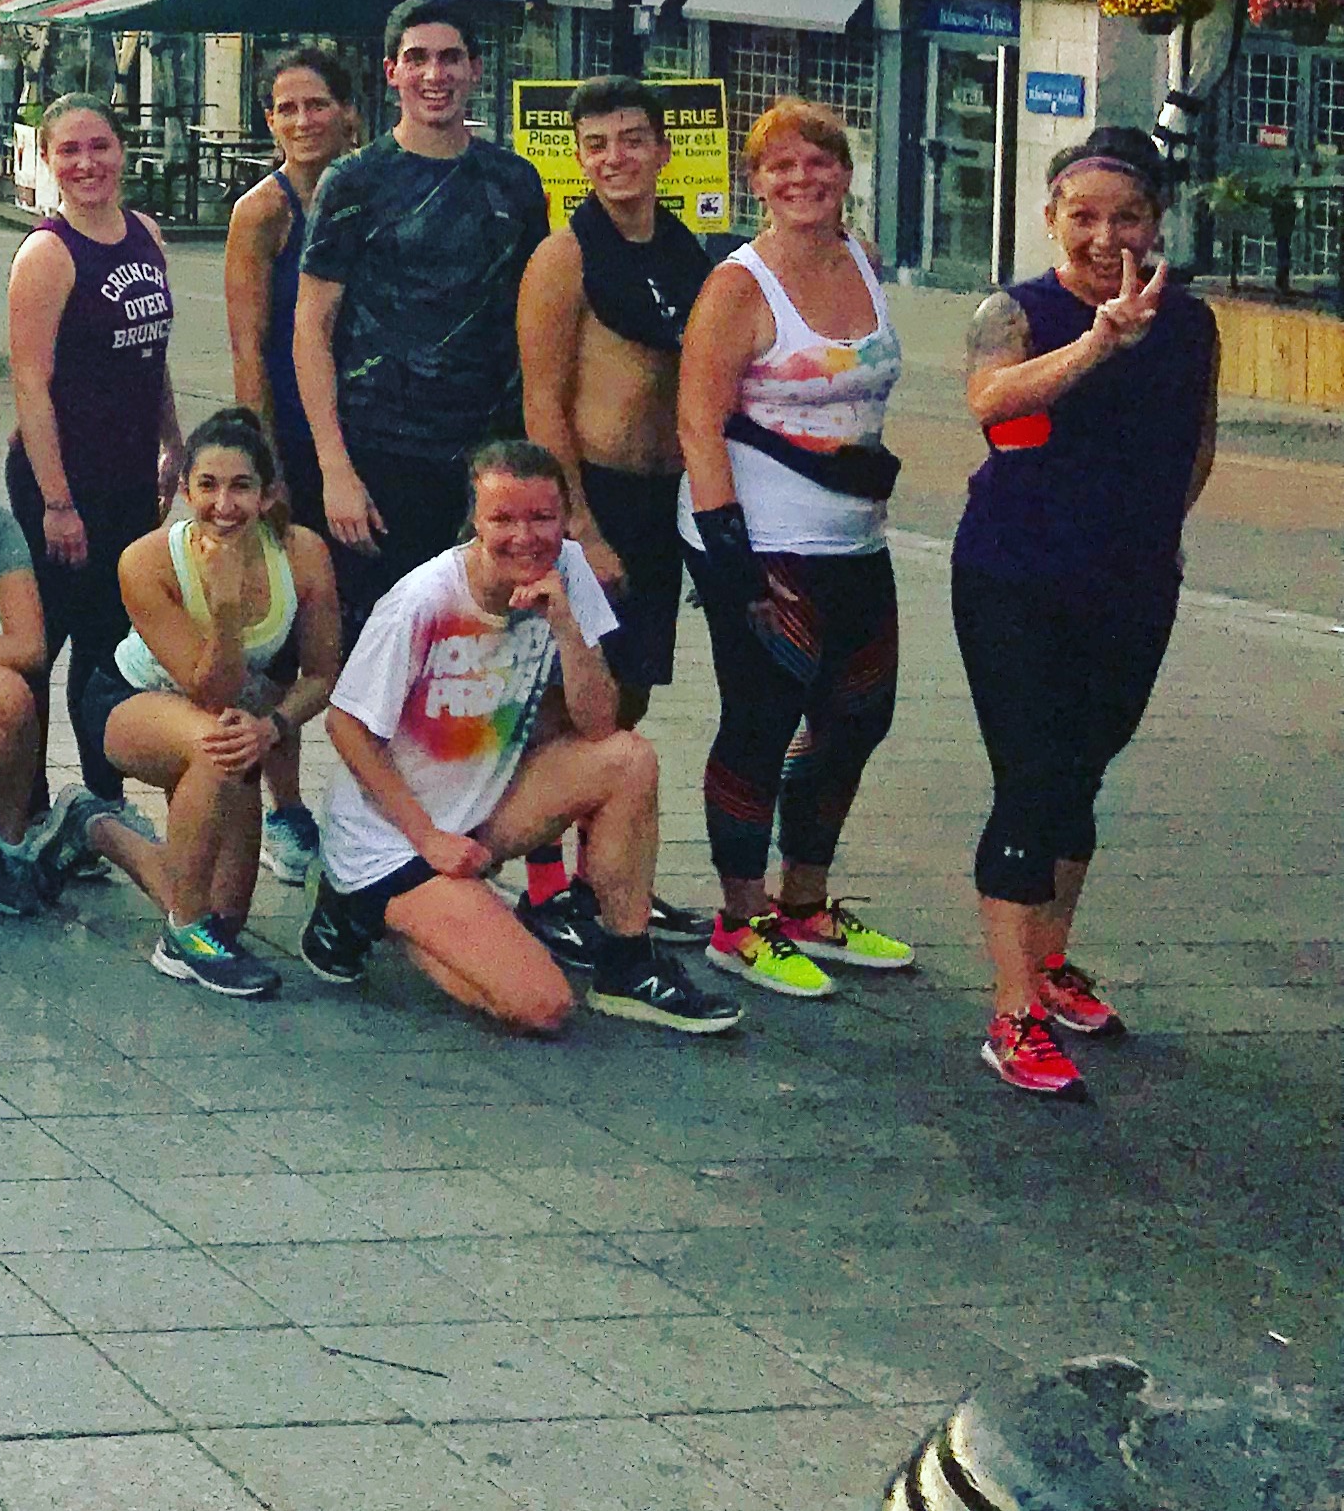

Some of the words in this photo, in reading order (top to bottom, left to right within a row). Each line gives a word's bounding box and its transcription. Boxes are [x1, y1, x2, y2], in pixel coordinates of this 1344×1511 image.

[679, 109, 717, 126] RUE
[529, 131, 570, 145] Place
[100, 262, 165, 302] CRUNCH
[124, 292, 169, 321] OVER
[111, 318, 173, 349] BRUNC
